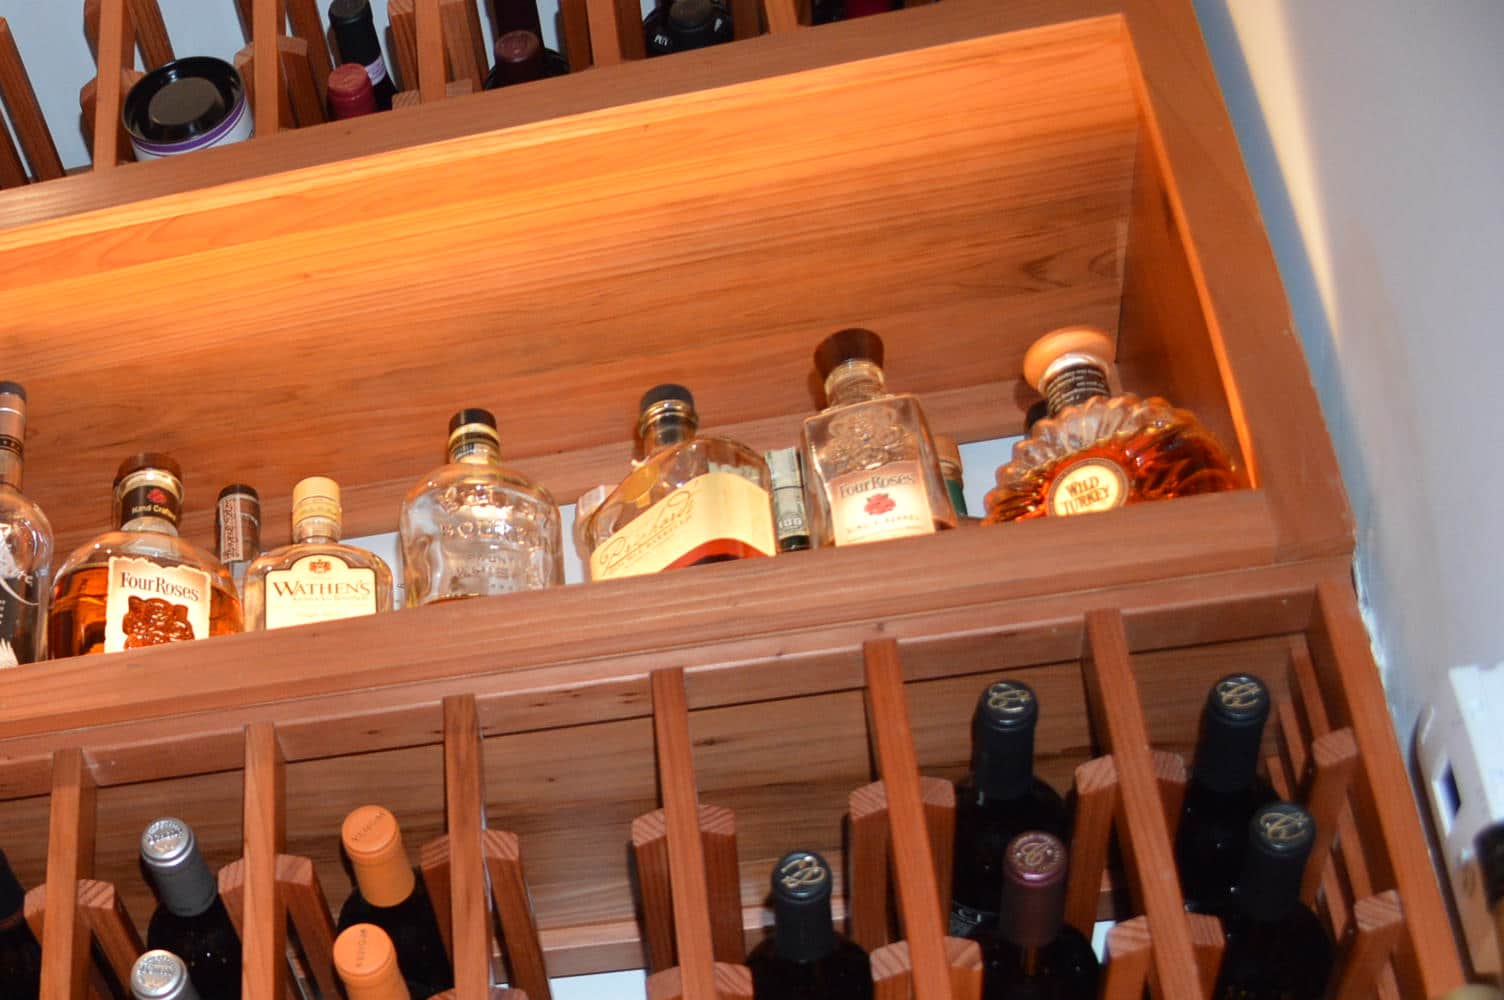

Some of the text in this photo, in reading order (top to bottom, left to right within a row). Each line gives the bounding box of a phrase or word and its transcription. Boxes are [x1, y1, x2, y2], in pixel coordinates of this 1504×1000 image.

[839, 473, 913, 499] Four Roses
[1065, 476, 1100, 497] WILD
[1064, 485, 1110, 515] TURKEY
[119, 571, 201, 602] Four Roses
[273, 579, 371, 597] WATHEN'S
